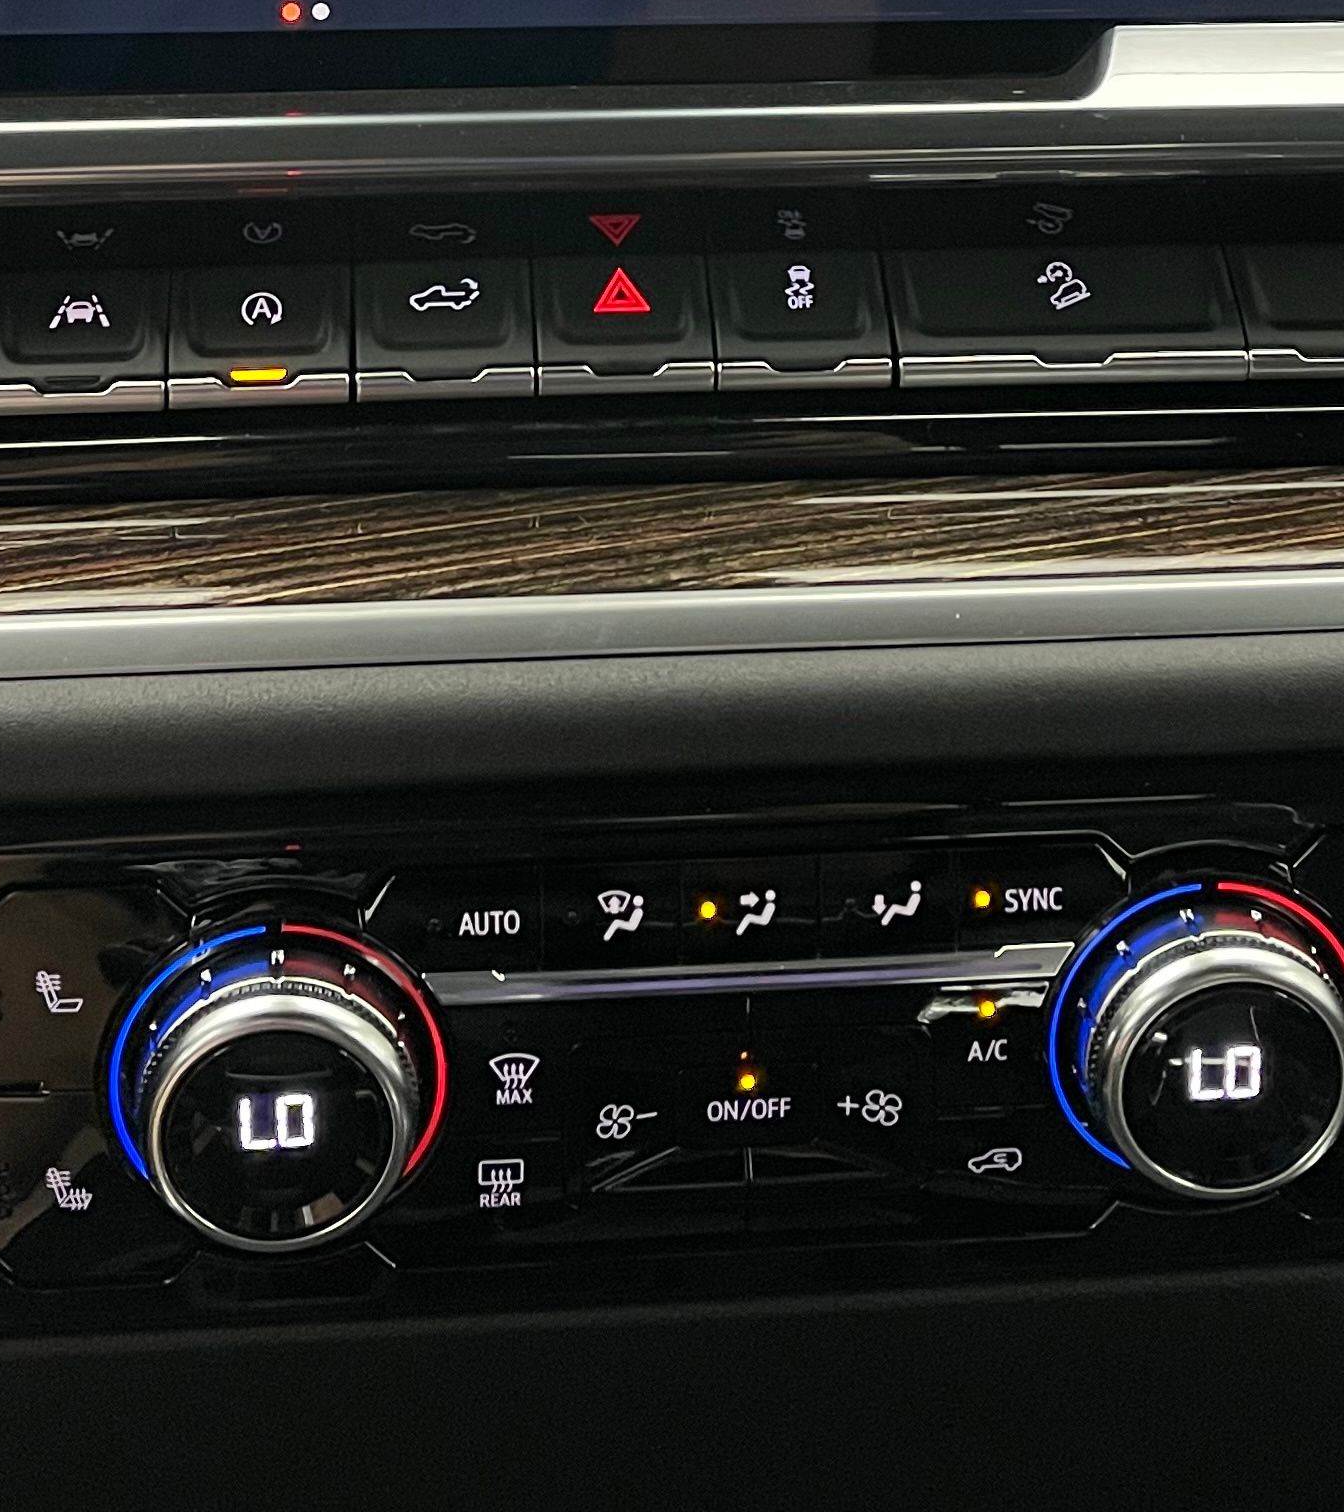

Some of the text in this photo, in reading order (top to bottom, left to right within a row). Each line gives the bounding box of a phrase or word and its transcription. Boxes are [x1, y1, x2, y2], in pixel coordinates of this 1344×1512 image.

[787, 295, 814, 310] OFF
[1004, 886, 1063, 913] SYNC
[458, 909, 521, 936] AUTO
[967, 1038, 1008, 1062] A/C
[496, 1089, 533, 1105] MAX
[706, 1097, 791, 1122] ON/OFF
[479, 1192, 521, 1208] REAR
